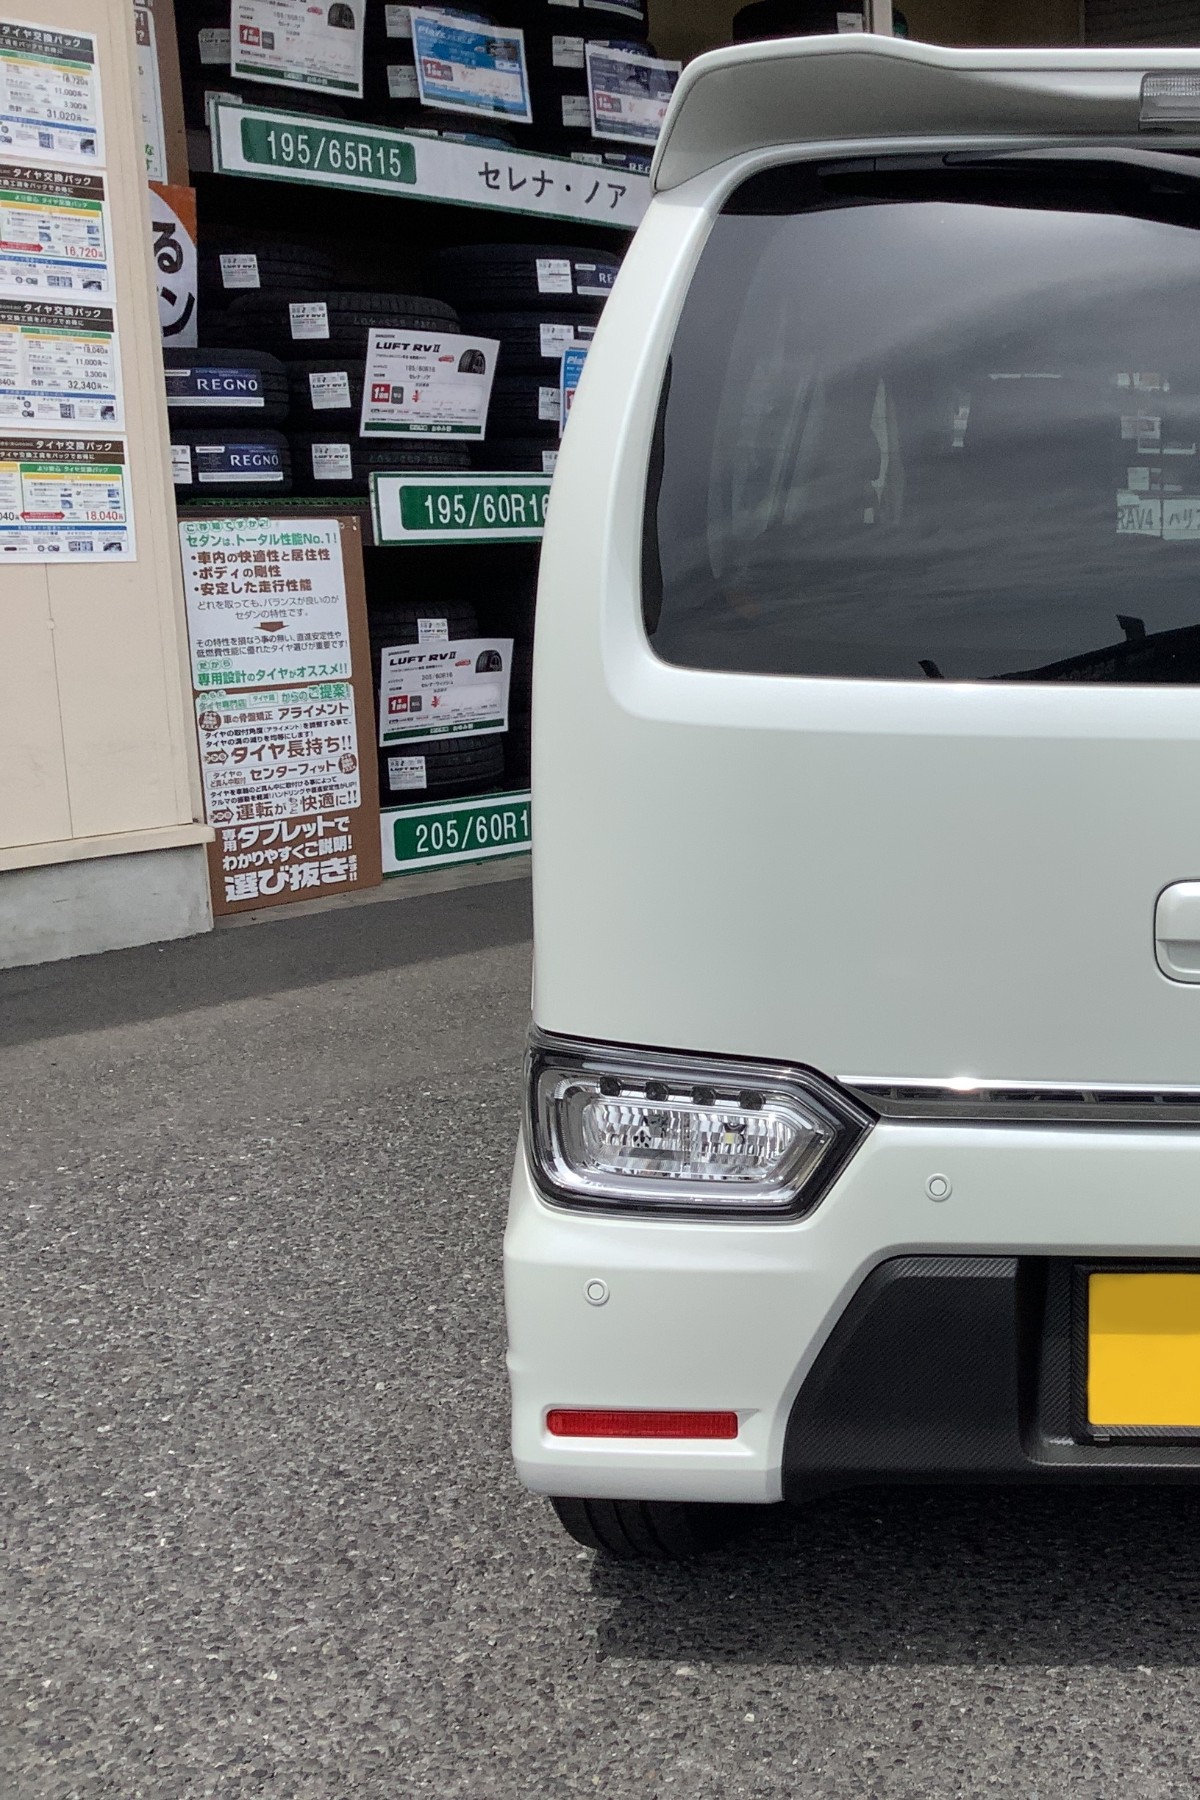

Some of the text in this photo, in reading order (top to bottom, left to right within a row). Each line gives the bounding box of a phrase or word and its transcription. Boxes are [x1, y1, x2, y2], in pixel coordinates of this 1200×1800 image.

[266, 130, 402, 178] 195/65R15
[13, 168, 92, 185] タイヤ交換パック
[478, 161, 627, 208] セレナ・ノア
[24, 303, 102, 318] タイヤ交換パック
[375, 342, 411, 351] LUFT
[197, 378, 258, 391] REGNO
[36, 440, 113, 452] タイヤ交換パック
[230, 454, 279, 467] REGNO
[389, 654, 426, 666] LUFT
[223, 711, 274, 724] 車の骨盤矯正
[278, 703, 350, 720] アライメント
[250, 760, 337, 782] センターフィット
[236, 801, 287, 821] 運転が
[222, 816, 350, 853] 専用 タブレットで
[416, 809, 529, 853] 205/60R1
[222, 835, 353, 872] わかりやすくご説明!
[224, 857, 348, 903] 選び抜き
